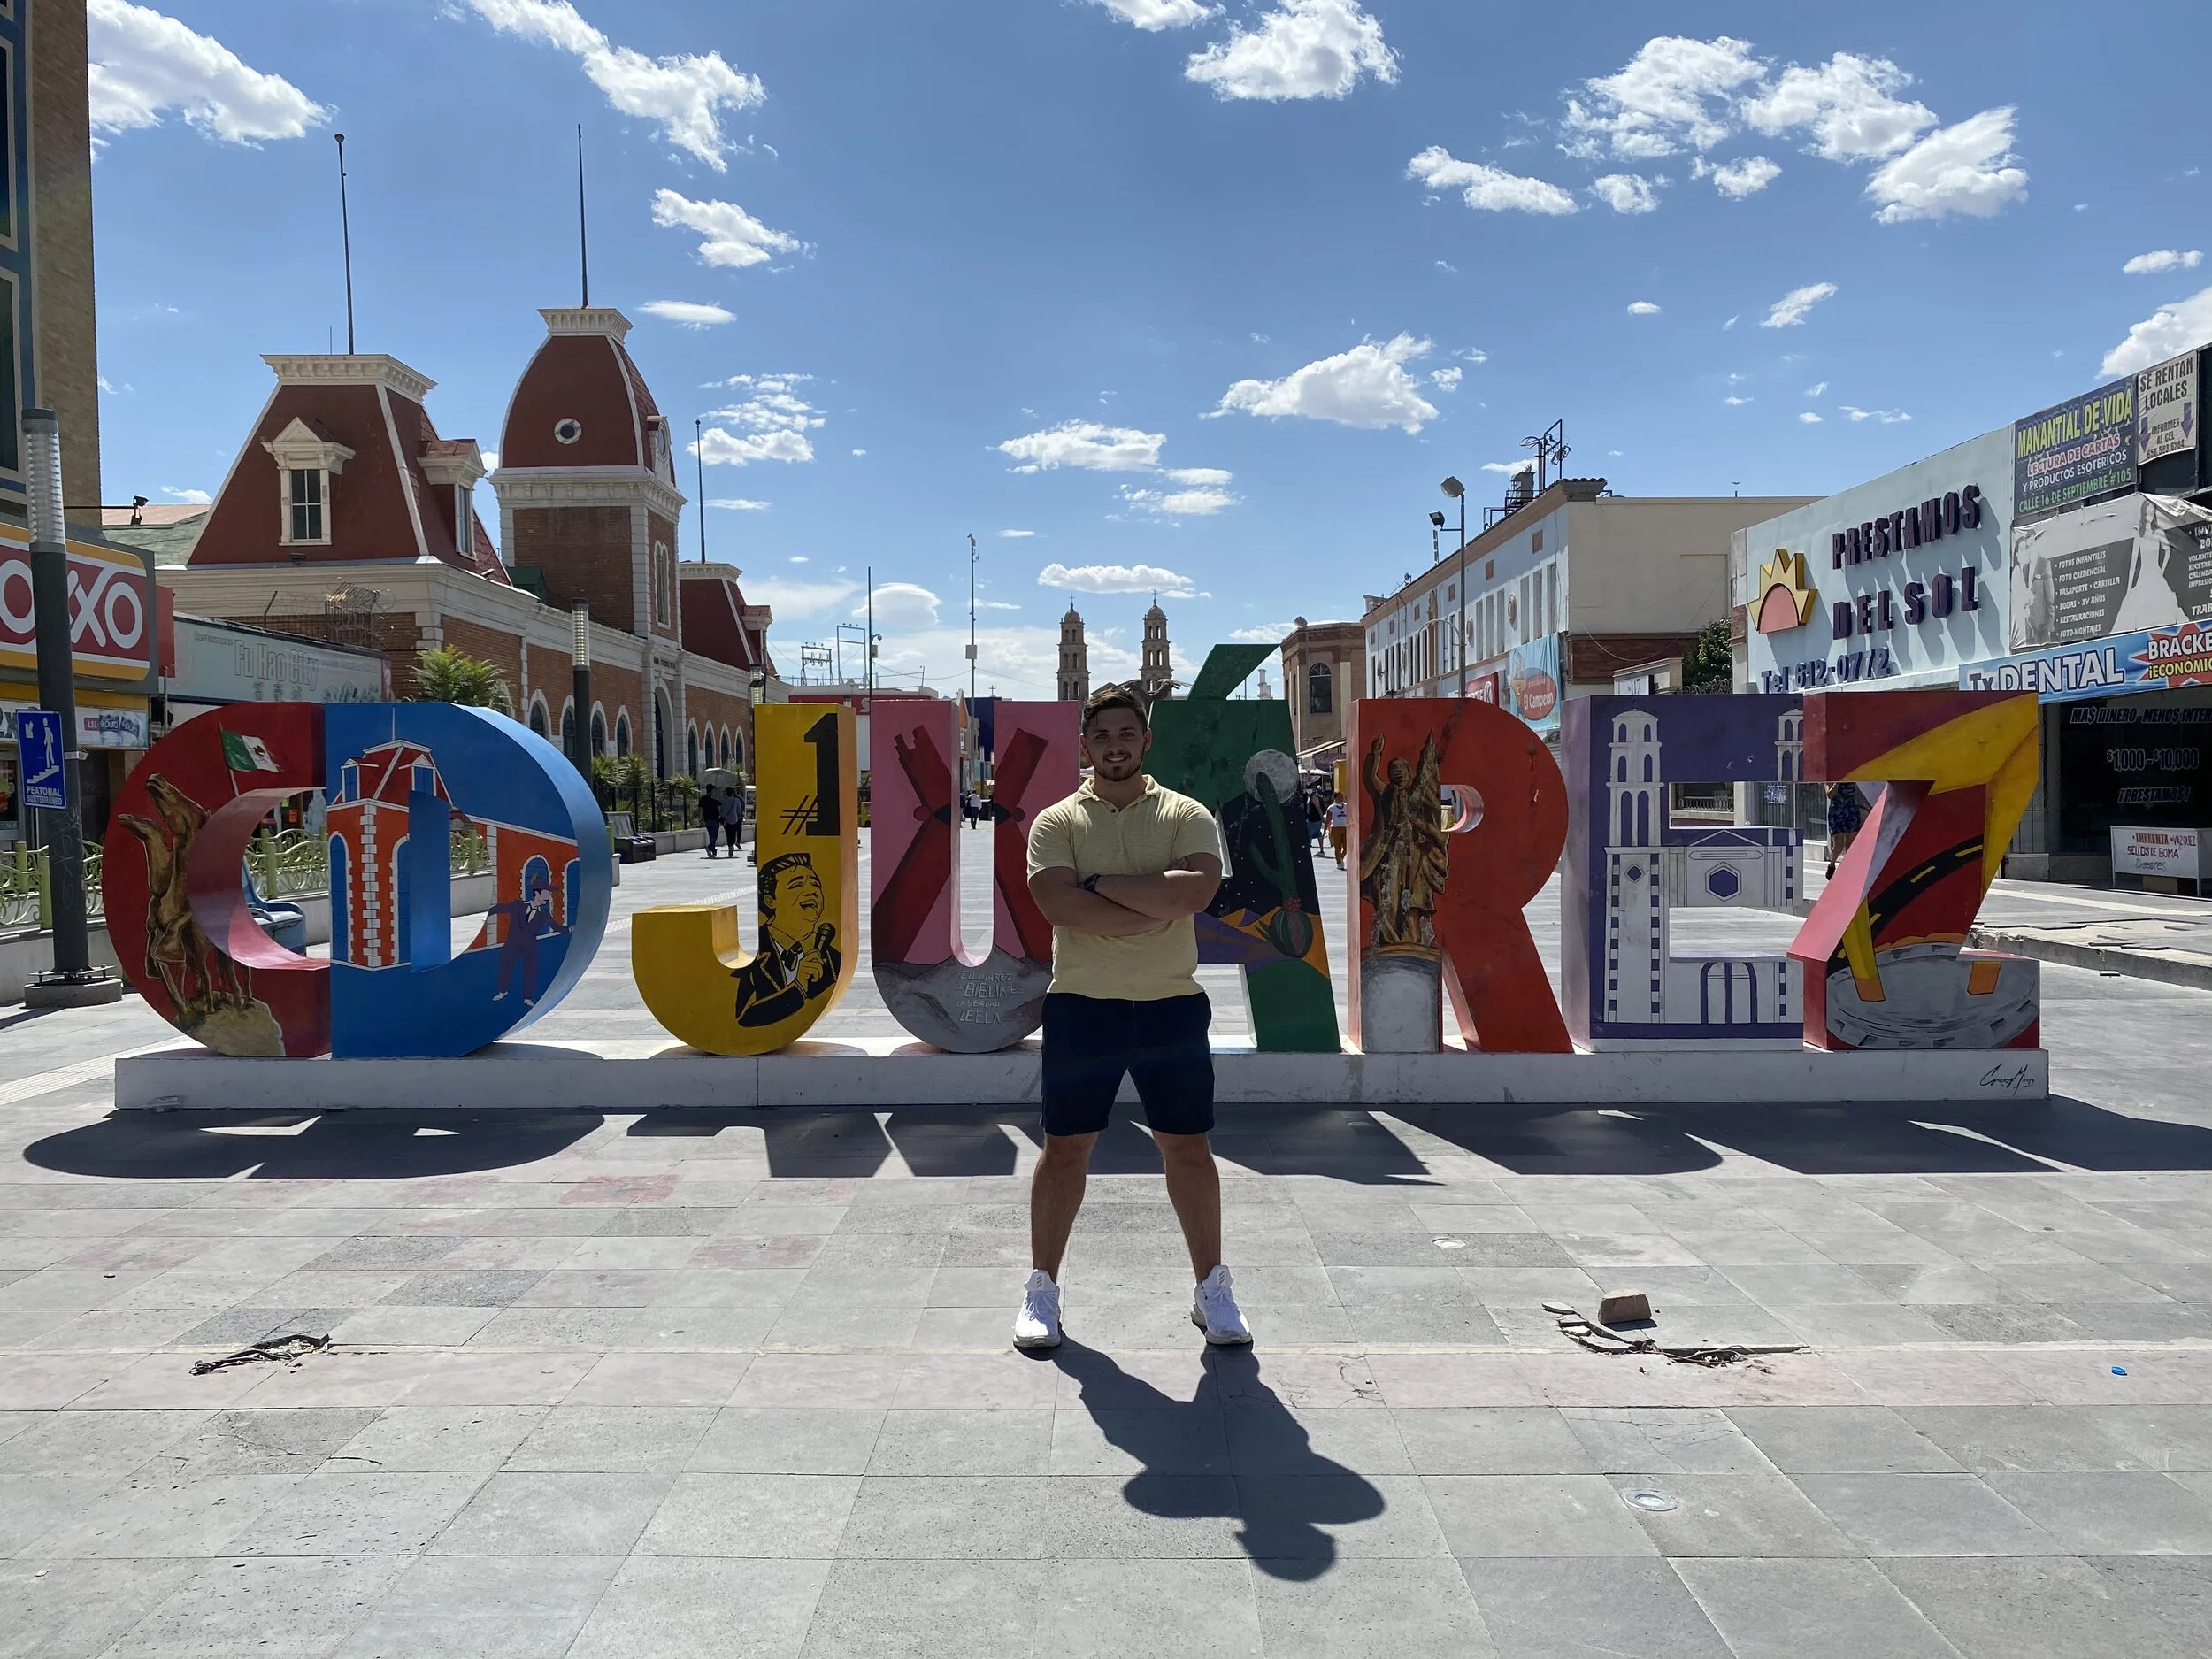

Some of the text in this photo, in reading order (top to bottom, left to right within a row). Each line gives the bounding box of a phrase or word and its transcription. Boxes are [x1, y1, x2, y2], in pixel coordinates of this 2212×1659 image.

[2140, 357, 2193, 392] SE RENTAN
[2146, 380, 2187, 411] LOCALES
[2018, 389, 2133, 458] MANANTIAL DE VIDA
[2152, 418, 2180, 434] INFORMES
[2157, 430, 2175, 445] AL CEL
[2027, 434, 2120, 476] LECTURA DE CARTAS
[2019, 470, 2131, 513] CALLE 16 DE SEPTIEMBRE #105
[2023, 480, 2028, 494] Y
[2029, 469, 2075, 490] PRODUCTOS
[1832, 484, 1980, 569] PRESTAMOS
[2059, 550, 2106, 569] FOTOS INFANTILES
[2059, 565, 2106, 582] FOTO CREDENCIAL
[2060, 576, 2120, 596] PASAPORTE CARTILLA
[1833, 567, 1978, 640] DEL SOL
[2060, 600, 2077, 611] BODAS
[2082, 597, 2090, 606] XV
[2060, 609, 2105, 624] RESTAURACIONES
[1761, 647, 1890, 694] Tel 612-0772
[1999, 648, 2125, 694] DENTAL
[2097, 707, 2138, 724] DINERO
[779, 713, 841, 836] #1
[27, 786, 62, 797] PEATONAL
[2127, 846, 2149, 856] SELLOS
[964, 982, 1008, 998] BIBLIA
[959, 1009, 1002, 1024] LEELA
